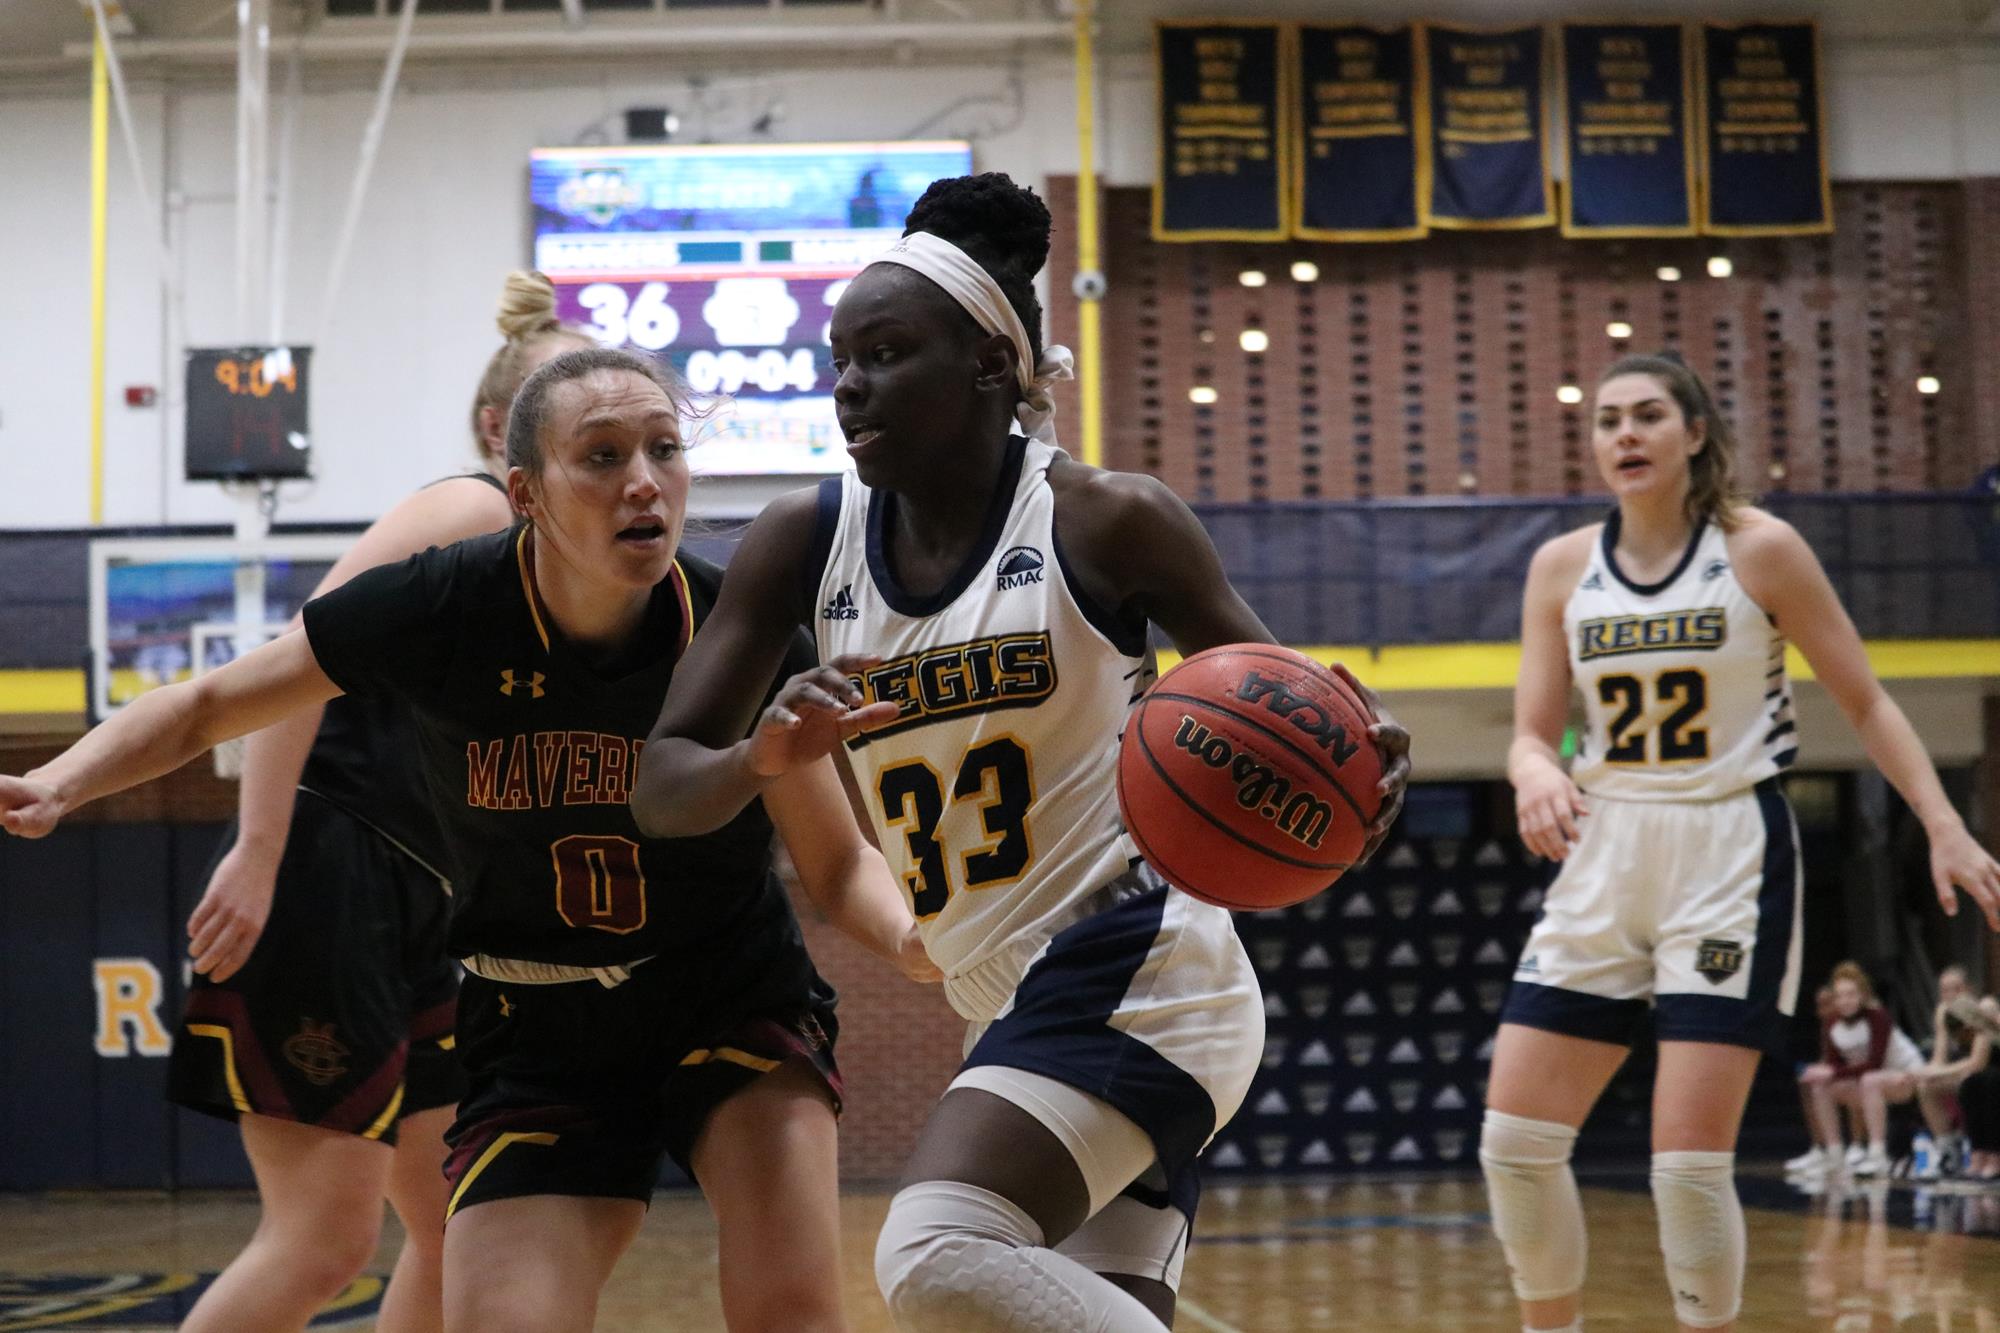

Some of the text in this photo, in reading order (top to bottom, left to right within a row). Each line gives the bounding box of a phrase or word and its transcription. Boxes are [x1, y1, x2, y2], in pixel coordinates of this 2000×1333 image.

[577, 282, 680, 350] 36
[997, 567, 1045, 592] RMAC
[1579, 607, 1726, 661] REGIS
[848, 631, 1058, 742] EGIS
[1236, 671, 1359, 767] NCAA
[1597, 666, 1711, 764] 22
[875, 731, 1037, 922] 33
[1173, 714, 1334, 850] Wilson
[550, 834, 647, 935] 0
